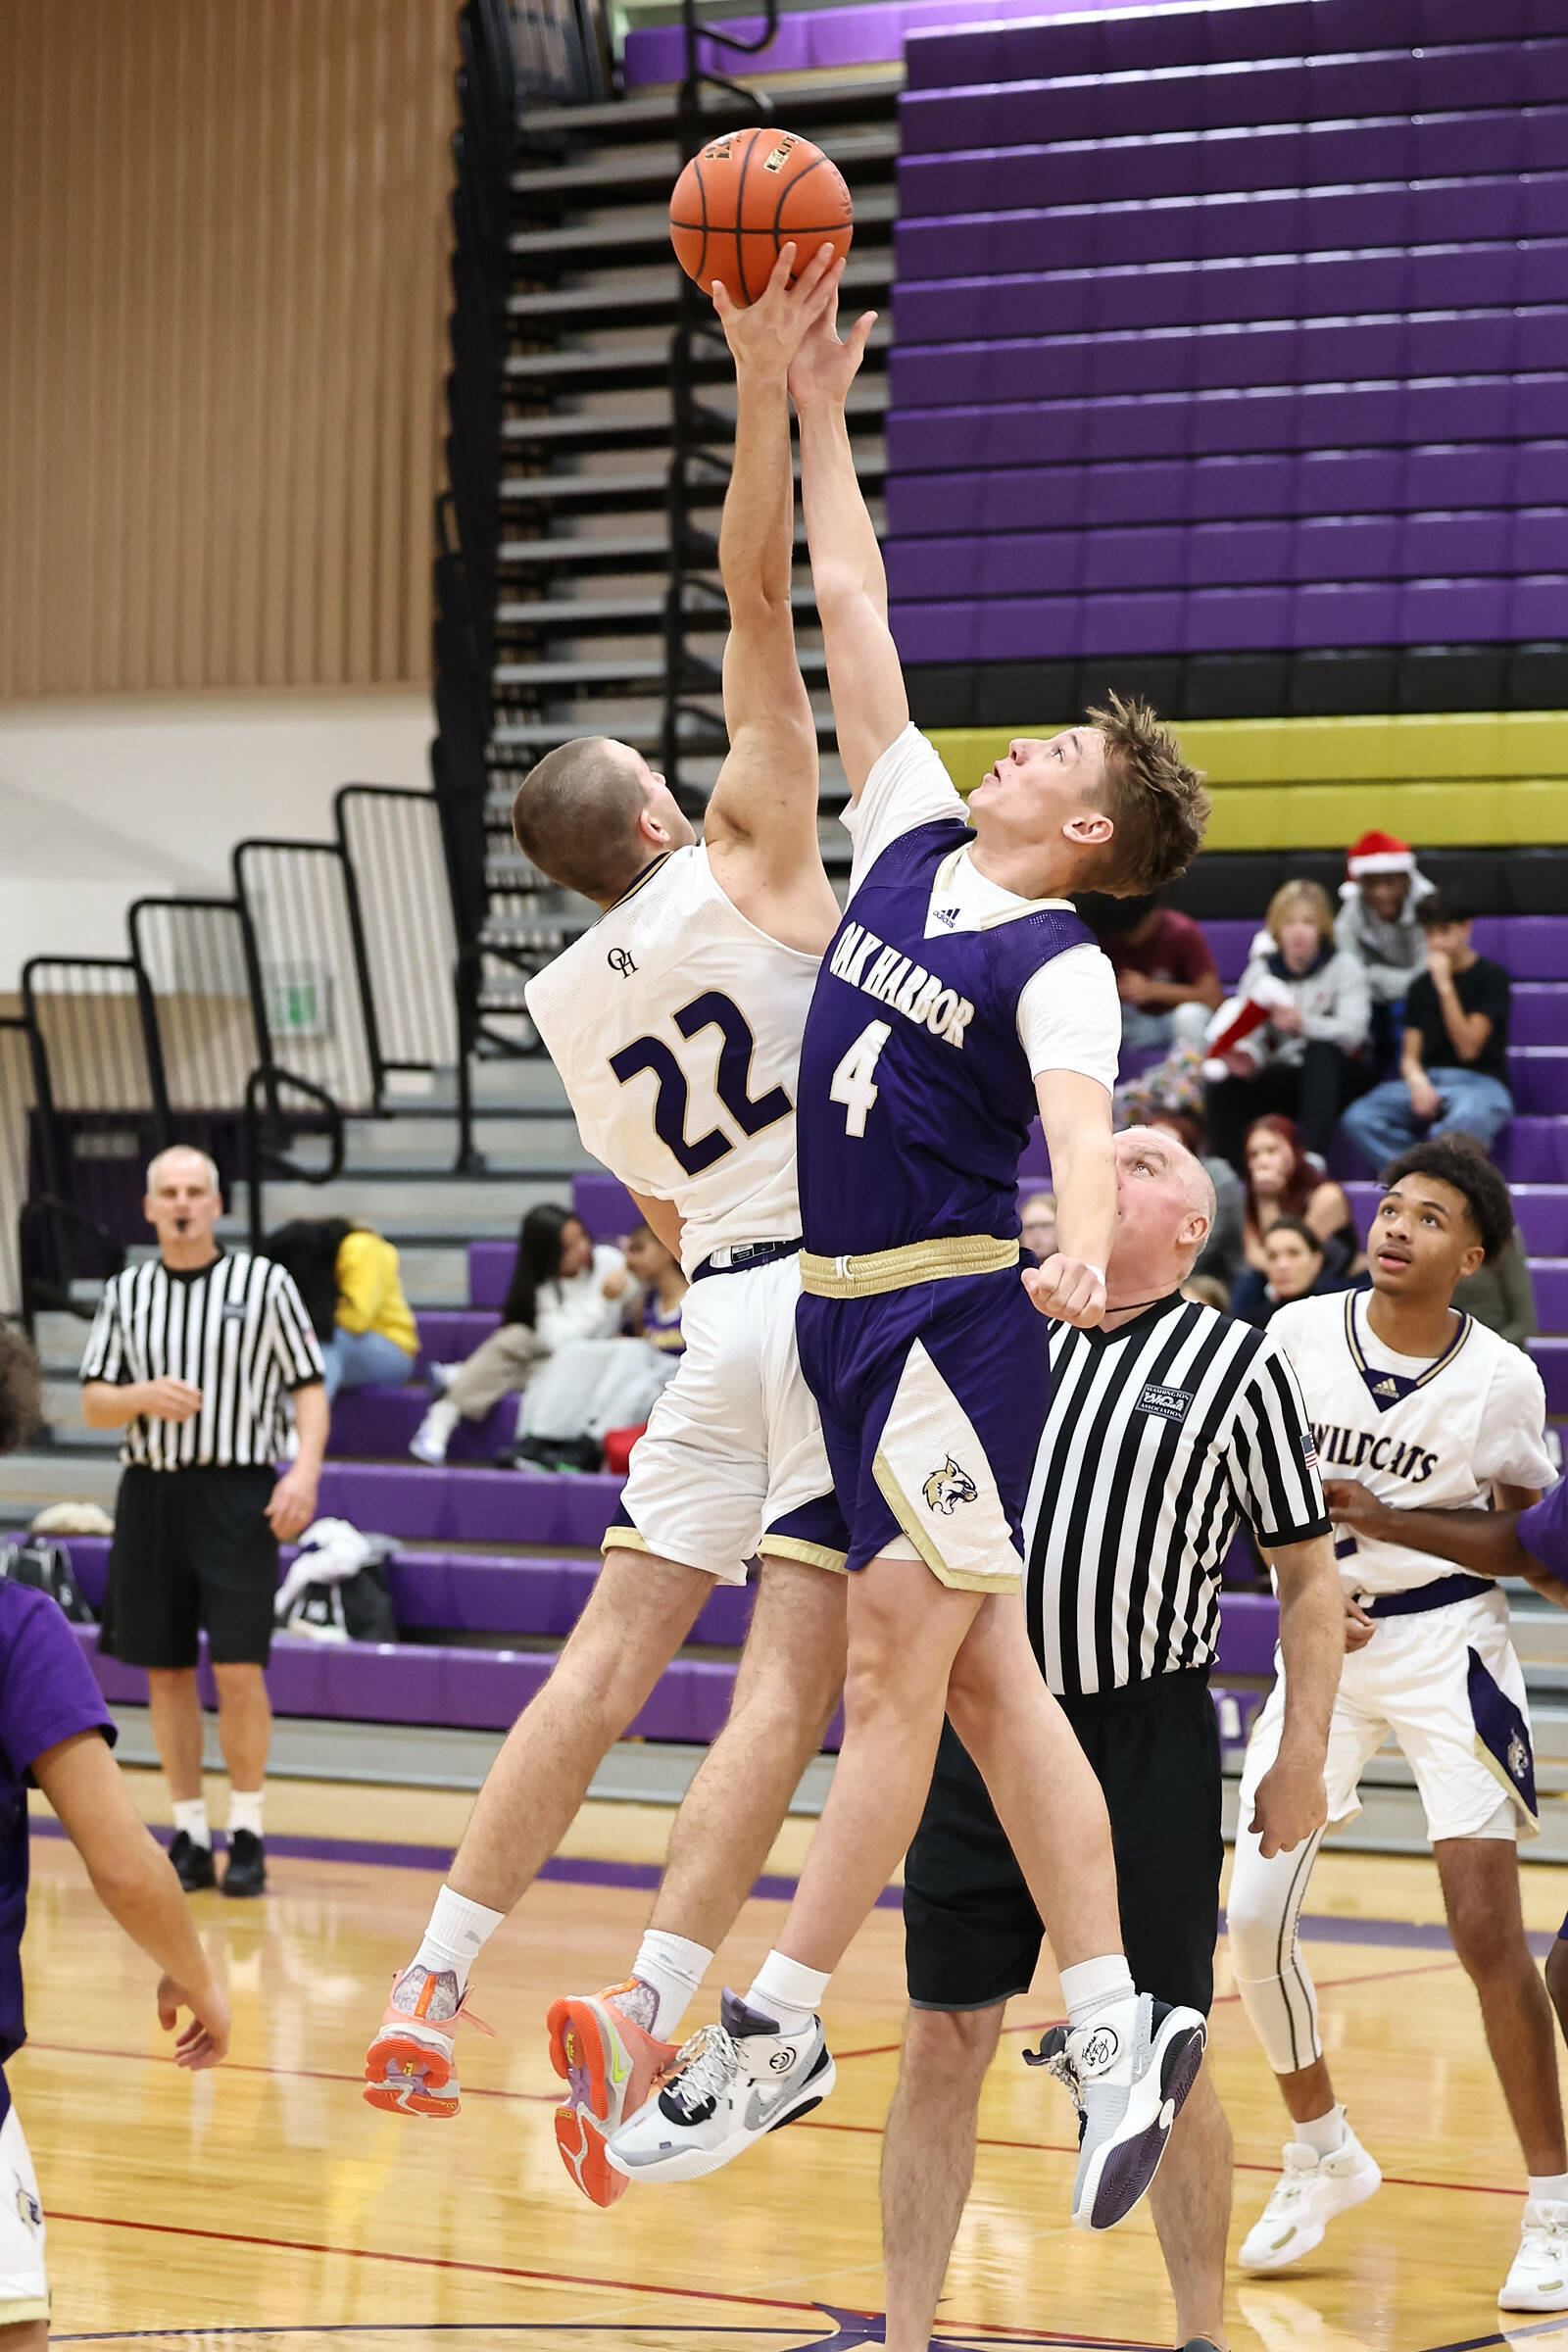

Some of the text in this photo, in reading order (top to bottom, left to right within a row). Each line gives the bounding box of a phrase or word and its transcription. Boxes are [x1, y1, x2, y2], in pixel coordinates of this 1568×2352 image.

[933, 910, 956, 929] adidas
[830, 920, 975, 1050] OAK HARBOR
[607, 988, 797, 1179] 22
[829, 1019, 893, 1139] 4
[1140, 1402, 1182, 1419] ASSOCIATION
[1146, 1387, 1190, 1400] WASHINGTON
[1309, 1422, 1439, 1484] WILDCATS
